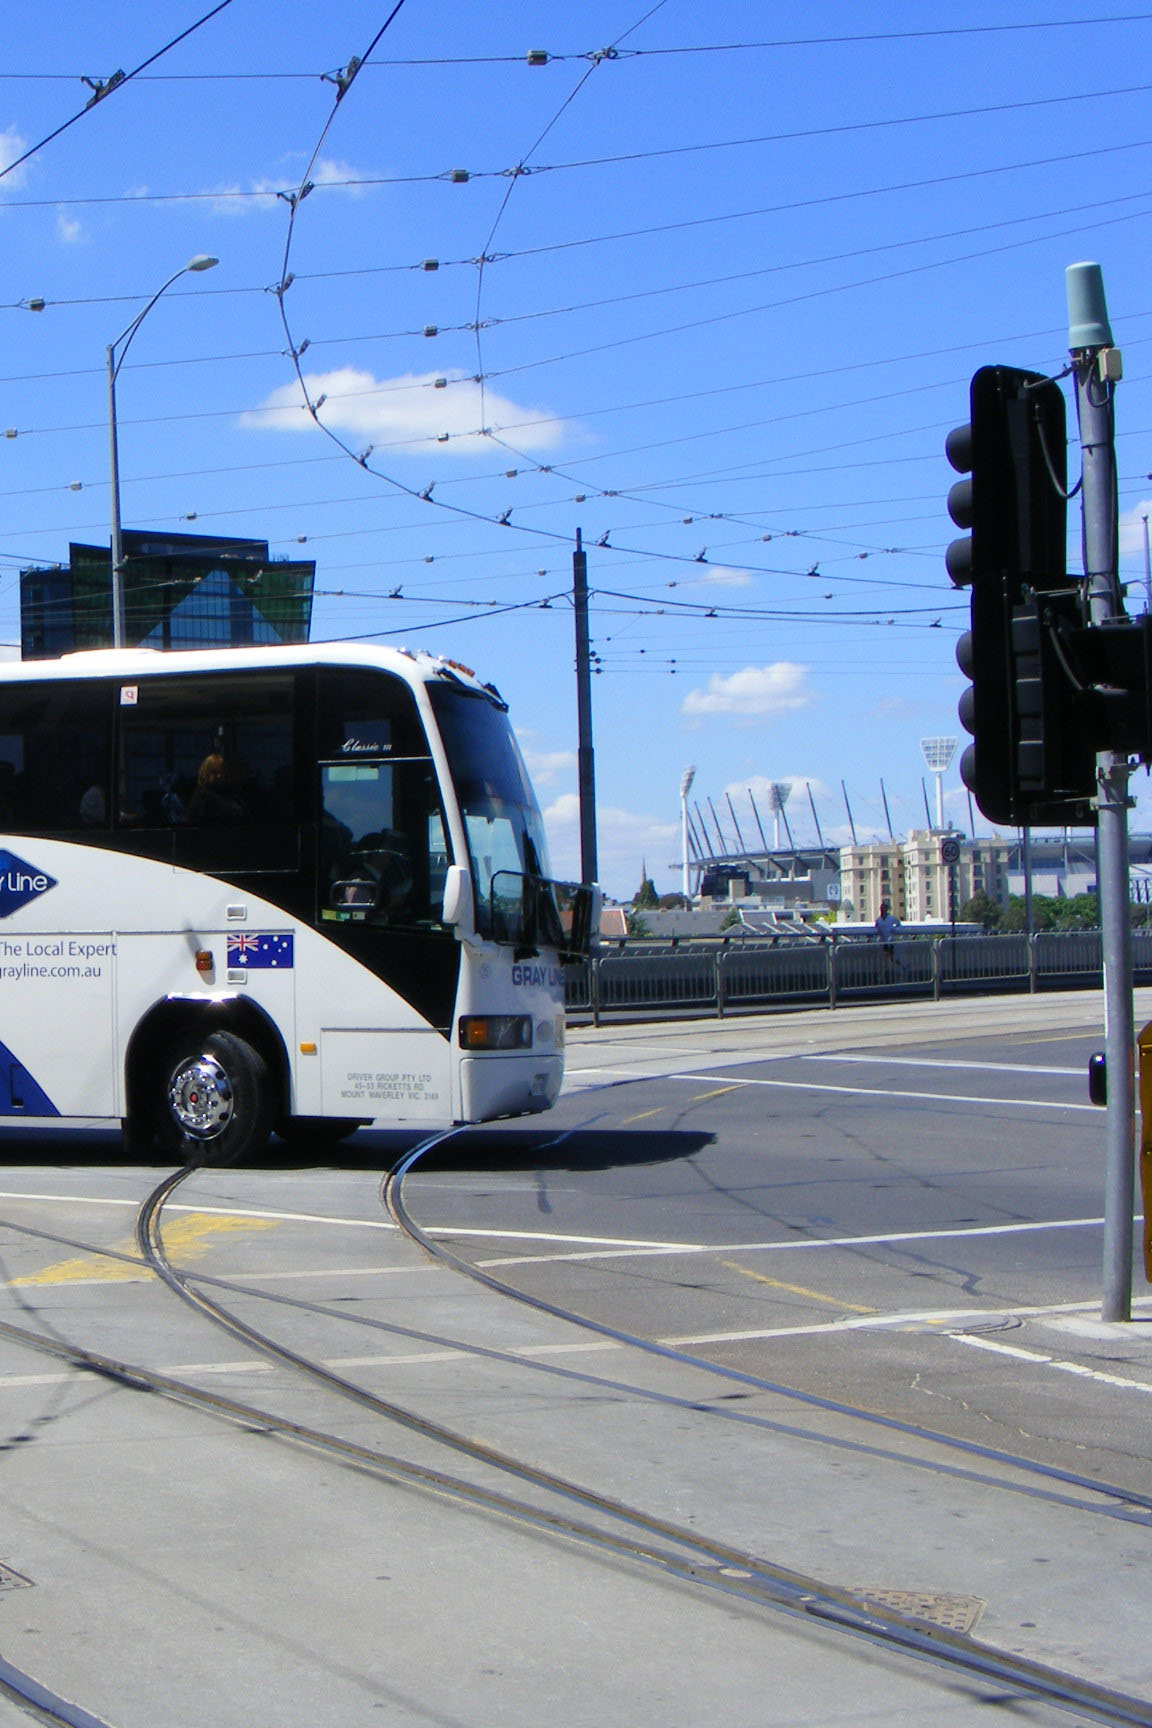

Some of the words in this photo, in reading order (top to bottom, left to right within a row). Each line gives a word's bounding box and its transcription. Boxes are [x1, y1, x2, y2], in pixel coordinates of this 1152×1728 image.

[341, 738, 379, 752] Classic
[944, 846, 958, 857] 60
[26, 941, 64, 956] Local
[68, 941, 118, 959] Expert
[512, 965, 547, 986] GRAY
[347, 1073, 373, 1081] DRIVER
[375, 1073, 400, 1081] GROUP
[401, 1074, 416, 1082] PTY
[376, 1082, 411, 1091] RICKETTS
[341, 1090, 365, 1098] MOUNT
[368, 1091, 404, 1099] WAVERLEY
